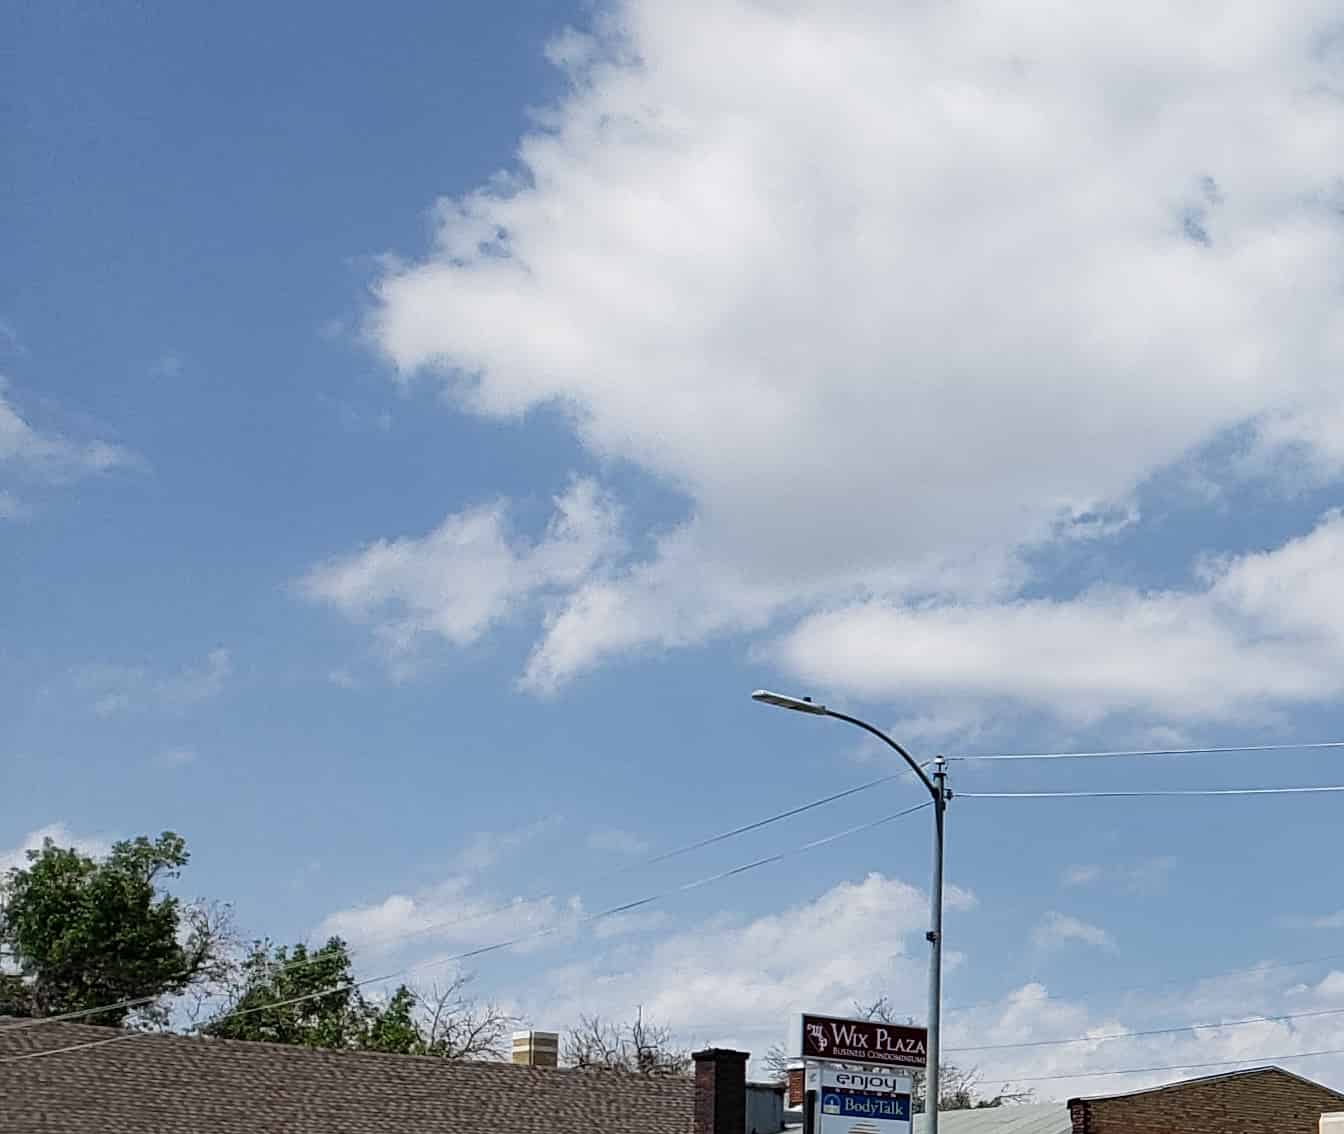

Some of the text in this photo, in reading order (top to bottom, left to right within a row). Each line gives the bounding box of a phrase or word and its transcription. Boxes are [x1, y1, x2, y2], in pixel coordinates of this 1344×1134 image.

[875, 1028, 926, 1055] PLAZA
[836, 1073, 896, 1092] enjoy
[844, 1097, 904, 1116] BodyTalk
